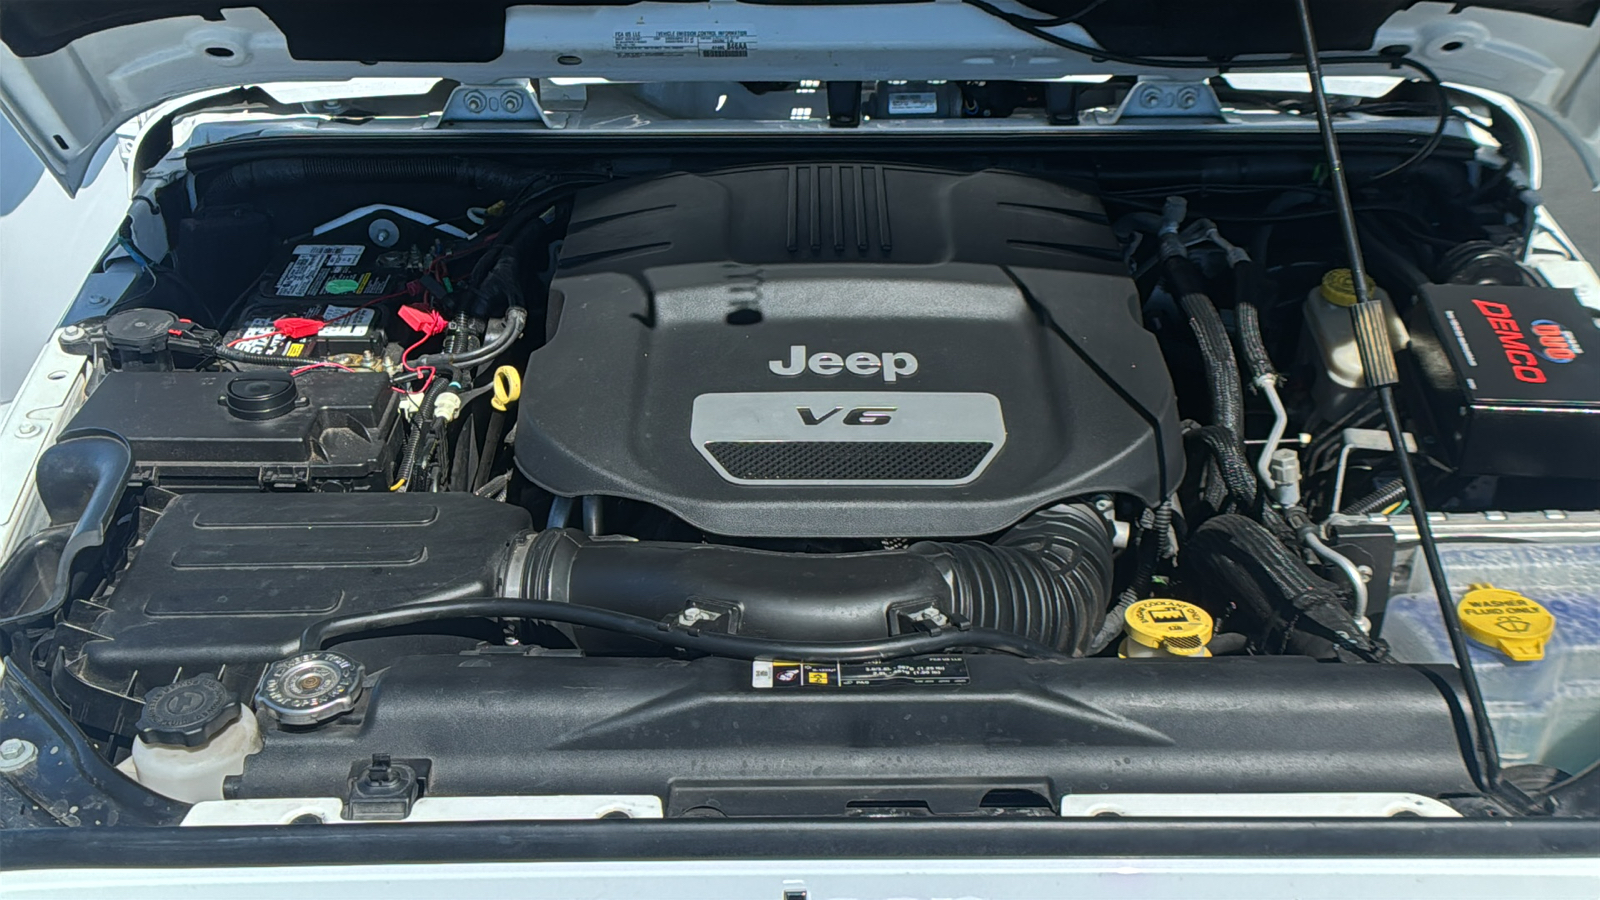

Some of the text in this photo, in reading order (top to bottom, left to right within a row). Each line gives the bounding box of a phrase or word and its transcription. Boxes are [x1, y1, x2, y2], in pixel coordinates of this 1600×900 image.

[1471, 299, 1547, 384] DEMCO
[768, 345, 919, 383] Jeep
[796, 406, 898, 426] V6
[1144, 601, 1188, 609] COOLANT
[1186, 608, 1202, 622] ONLY
[1464, 607, 1540, 616] FLUID ONLY
[1467, 600, 1528, 608] WASHER
